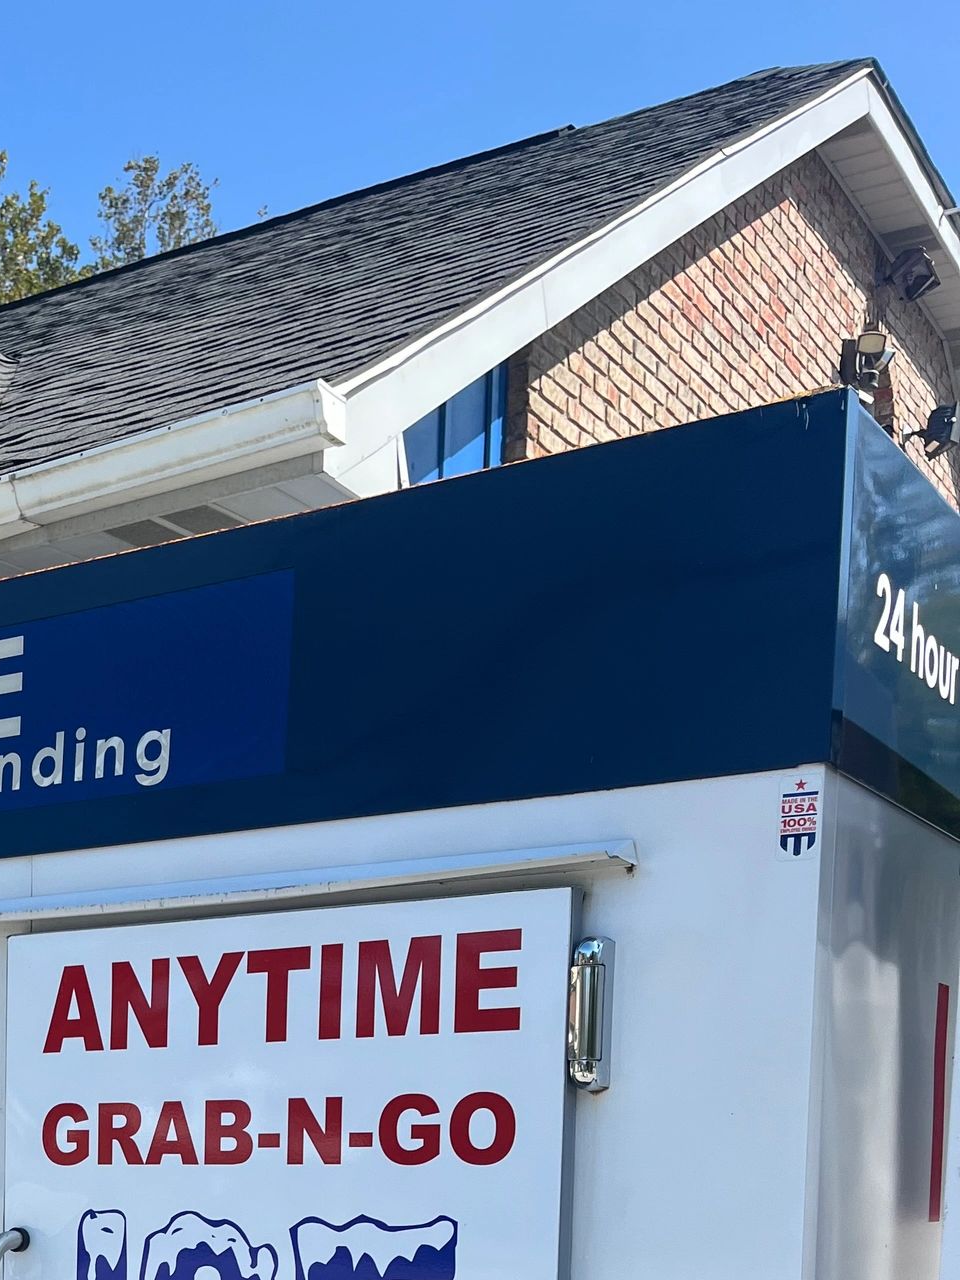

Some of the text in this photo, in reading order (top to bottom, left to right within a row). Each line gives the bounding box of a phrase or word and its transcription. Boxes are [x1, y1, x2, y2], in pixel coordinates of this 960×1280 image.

[874, 573, 959, 705] 24 hour
[780, 817, 816, 828] 100%
[781, 803, 817, 814] USA
[42, 928, 522, 1054] ANYTIME
[41, 1091, 516, 1166] GRAB-N-GO
